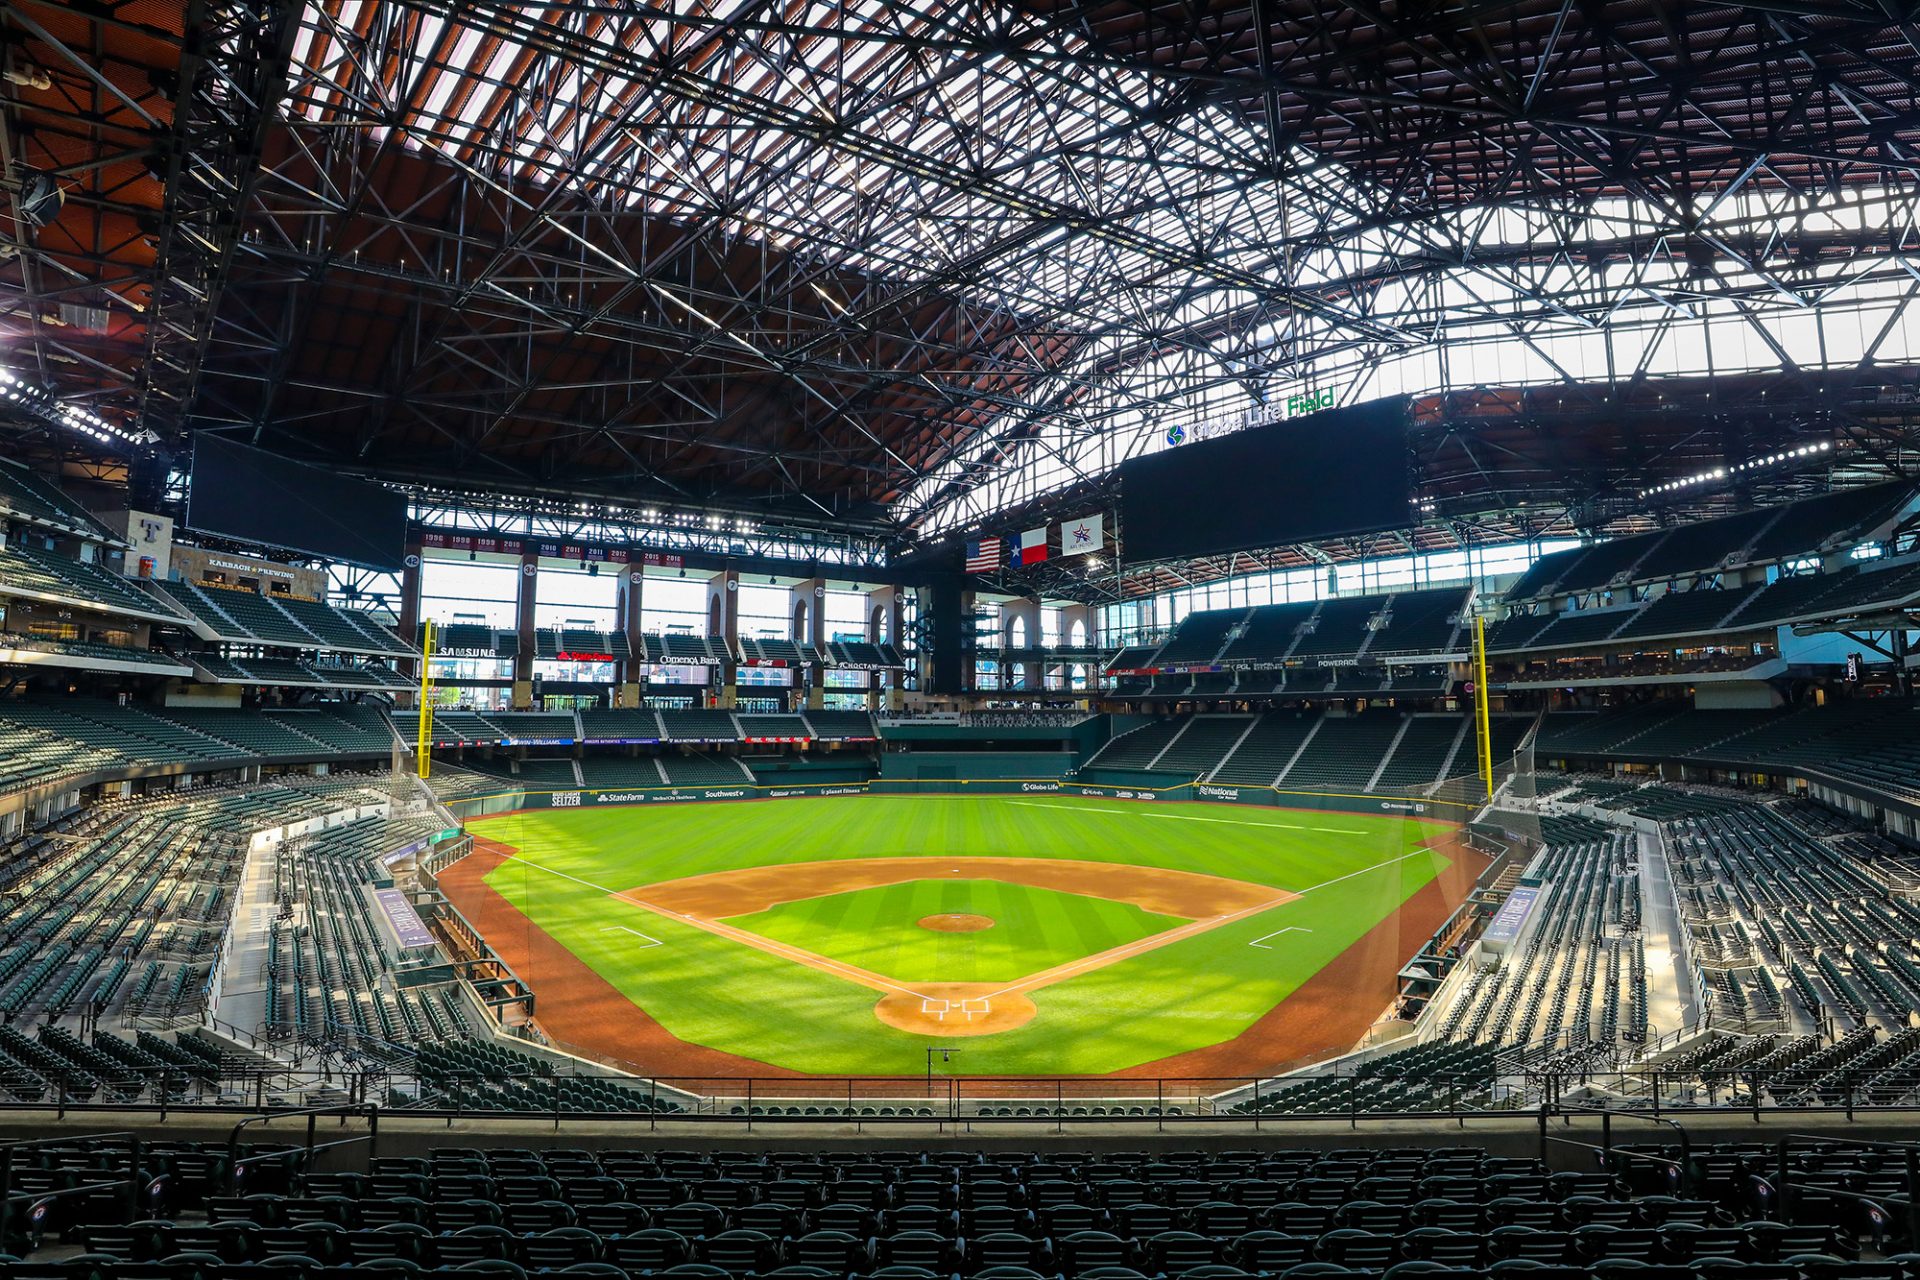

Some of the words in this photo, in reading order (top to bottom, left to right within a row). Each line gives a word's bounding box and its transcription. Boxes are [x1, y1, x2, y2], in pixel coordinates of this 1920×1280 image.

[1191, 417, 1243, 438] Globe
[1246, 404, 1282, 427] Life
[1287, 385, 1334, 417] Field
[141, 518, 164, 543] T
[565, 545, 581, 553] 2011
[588, 548, 603, 556] 2011
[611, 550, 627, 558] 2012
[209, 559, 251, 572] KARBACH
[406, 556, 418, 566] 42
[525, 566, 536, 575] 34
[632, 573, 641, 582] 26
[440, 647, 496, 657] SAMSUNG
[701, 656, 721, 665] Bank
[842, 661, 878, 669] CHOCTAW
[1318, 659, 1359, 668] POWERADE
[1030, 783, 1046, 791] Globe
[1208, 787, 1238, 796] National
[705, 790, 739, 798] Southwest
[552, 796, 581, 807] SELTZER
